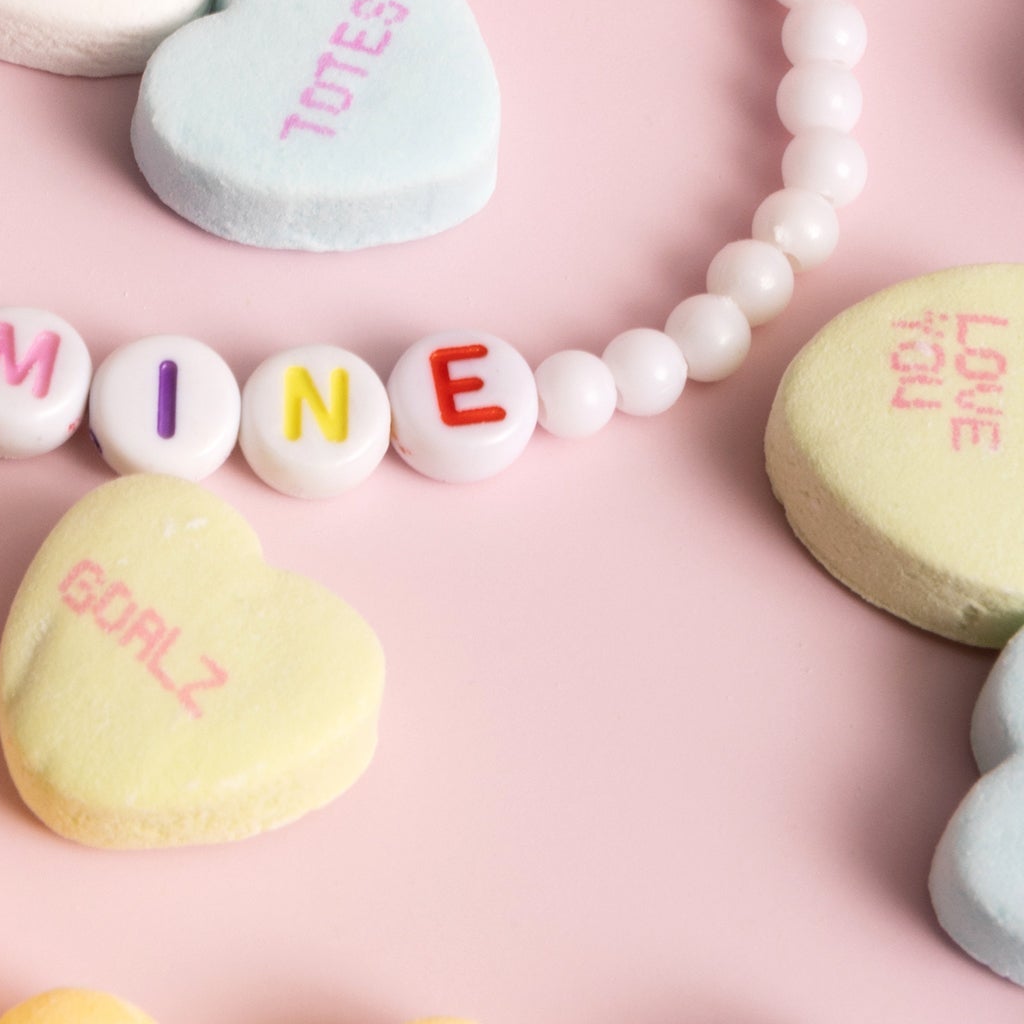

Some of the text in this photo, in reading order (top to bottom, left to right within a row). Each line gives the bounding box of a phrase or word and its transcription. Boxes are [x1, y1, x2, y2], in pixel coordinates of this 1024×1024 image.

[890, 310, 946, 412] YOU
[950, 311, 1010, 452] LOVE
[57, 558, 228, 720] GOALZ
